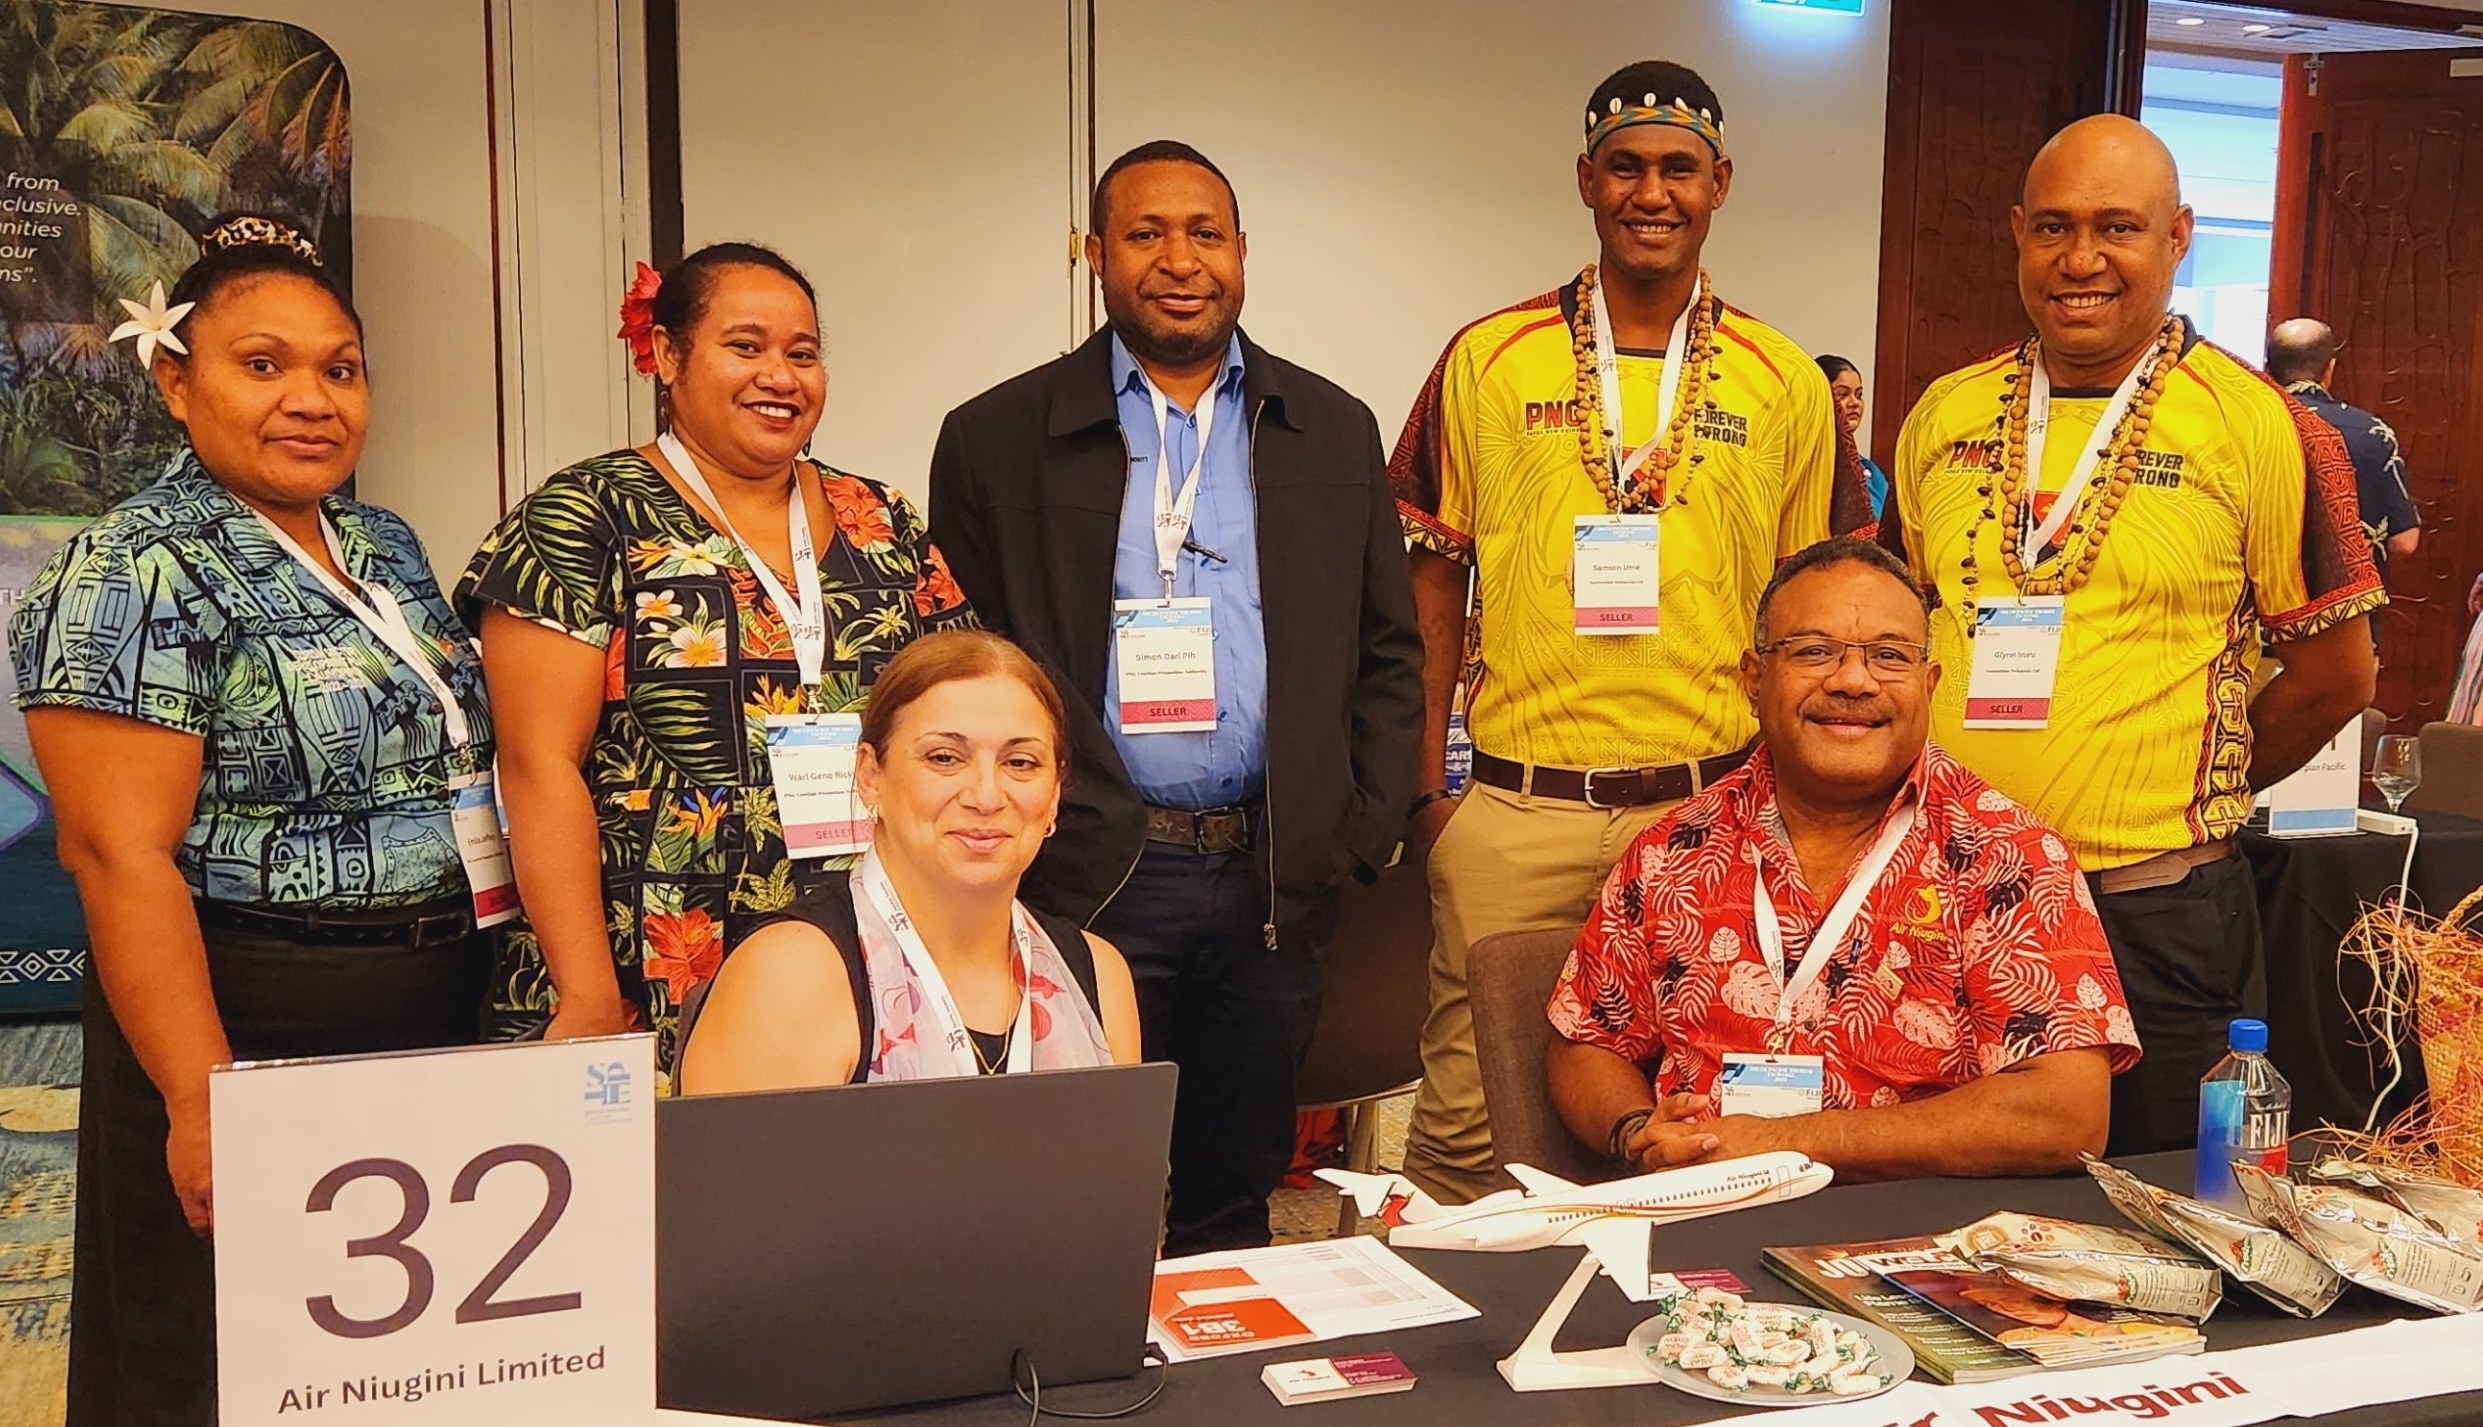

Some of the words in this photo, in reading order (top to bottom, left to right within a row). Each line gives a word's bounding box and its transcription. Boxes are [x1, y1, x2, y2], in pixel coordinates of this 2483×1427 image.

[7, 172, 60, 192] from
[0, 220, 62, 238] nities
[1694, 424, 1748, 447] SRONG
[2134, 449, 2184, 471] REVER
[2134, 469, 2181, 488] RONG
[1600, 613, 1634, 622] SELLER
[1136, 653, 1163, 661] Simon
[1150, 707, 1187, 717] SELLER
[1990, 705, 2023, 714] SELLER
[2321, 762, 2347, 771] Pacific
[1889, 922, 1909, 935] Air
[2250, 1110, 2288, 1149] FIJI
[306, 1143, 582, 1339] 32
[1180, 1319, 1247, 1336] 3B1
[277, 1385, 331, 1414] Air
[342, 1364, 466, 1403] Niugini
[479, 1345, 605, 1386] Limited
[1970, 1371, 2252, 1427] Niugini
